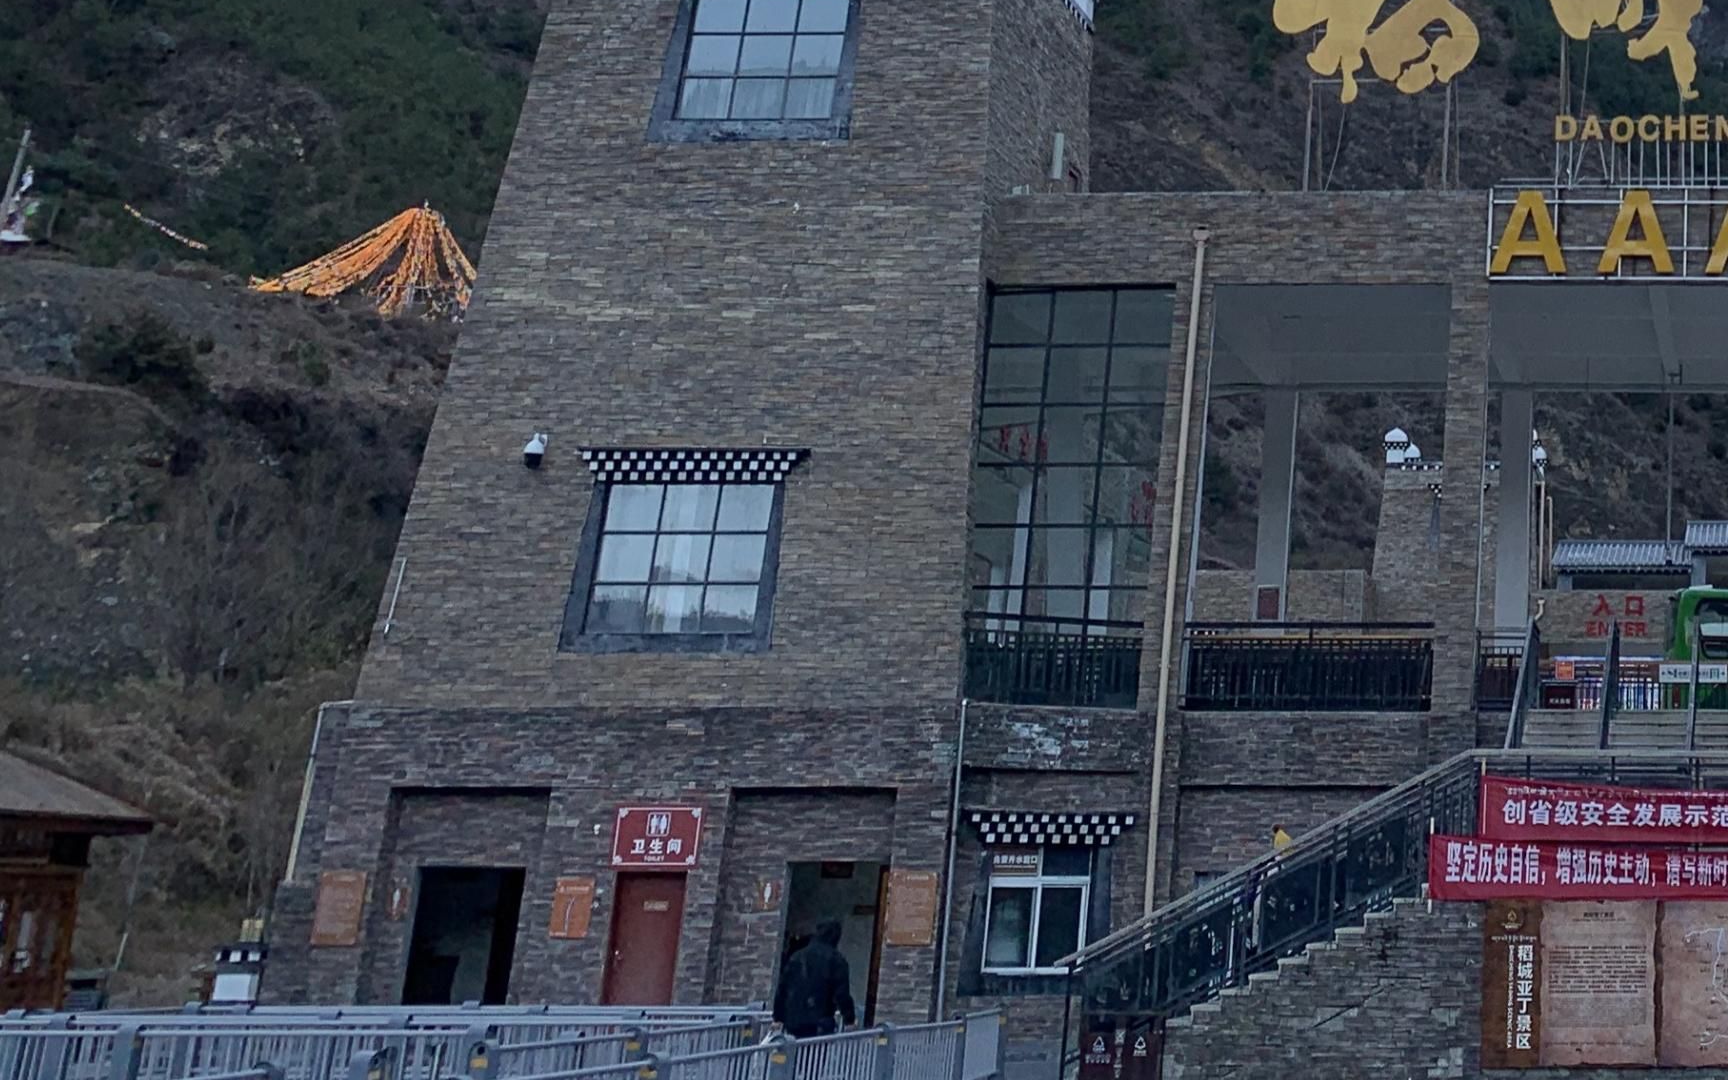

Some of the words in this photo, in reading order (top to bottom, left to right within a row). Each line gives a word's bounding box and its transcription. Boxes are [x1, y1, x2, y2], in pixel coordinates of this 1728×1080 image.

[1592, 593, 1644, 617] 入口
[630, 838, 682, 855] 卫生间
[1516, 944, 1534, 1050] 稻城亚丁景区
